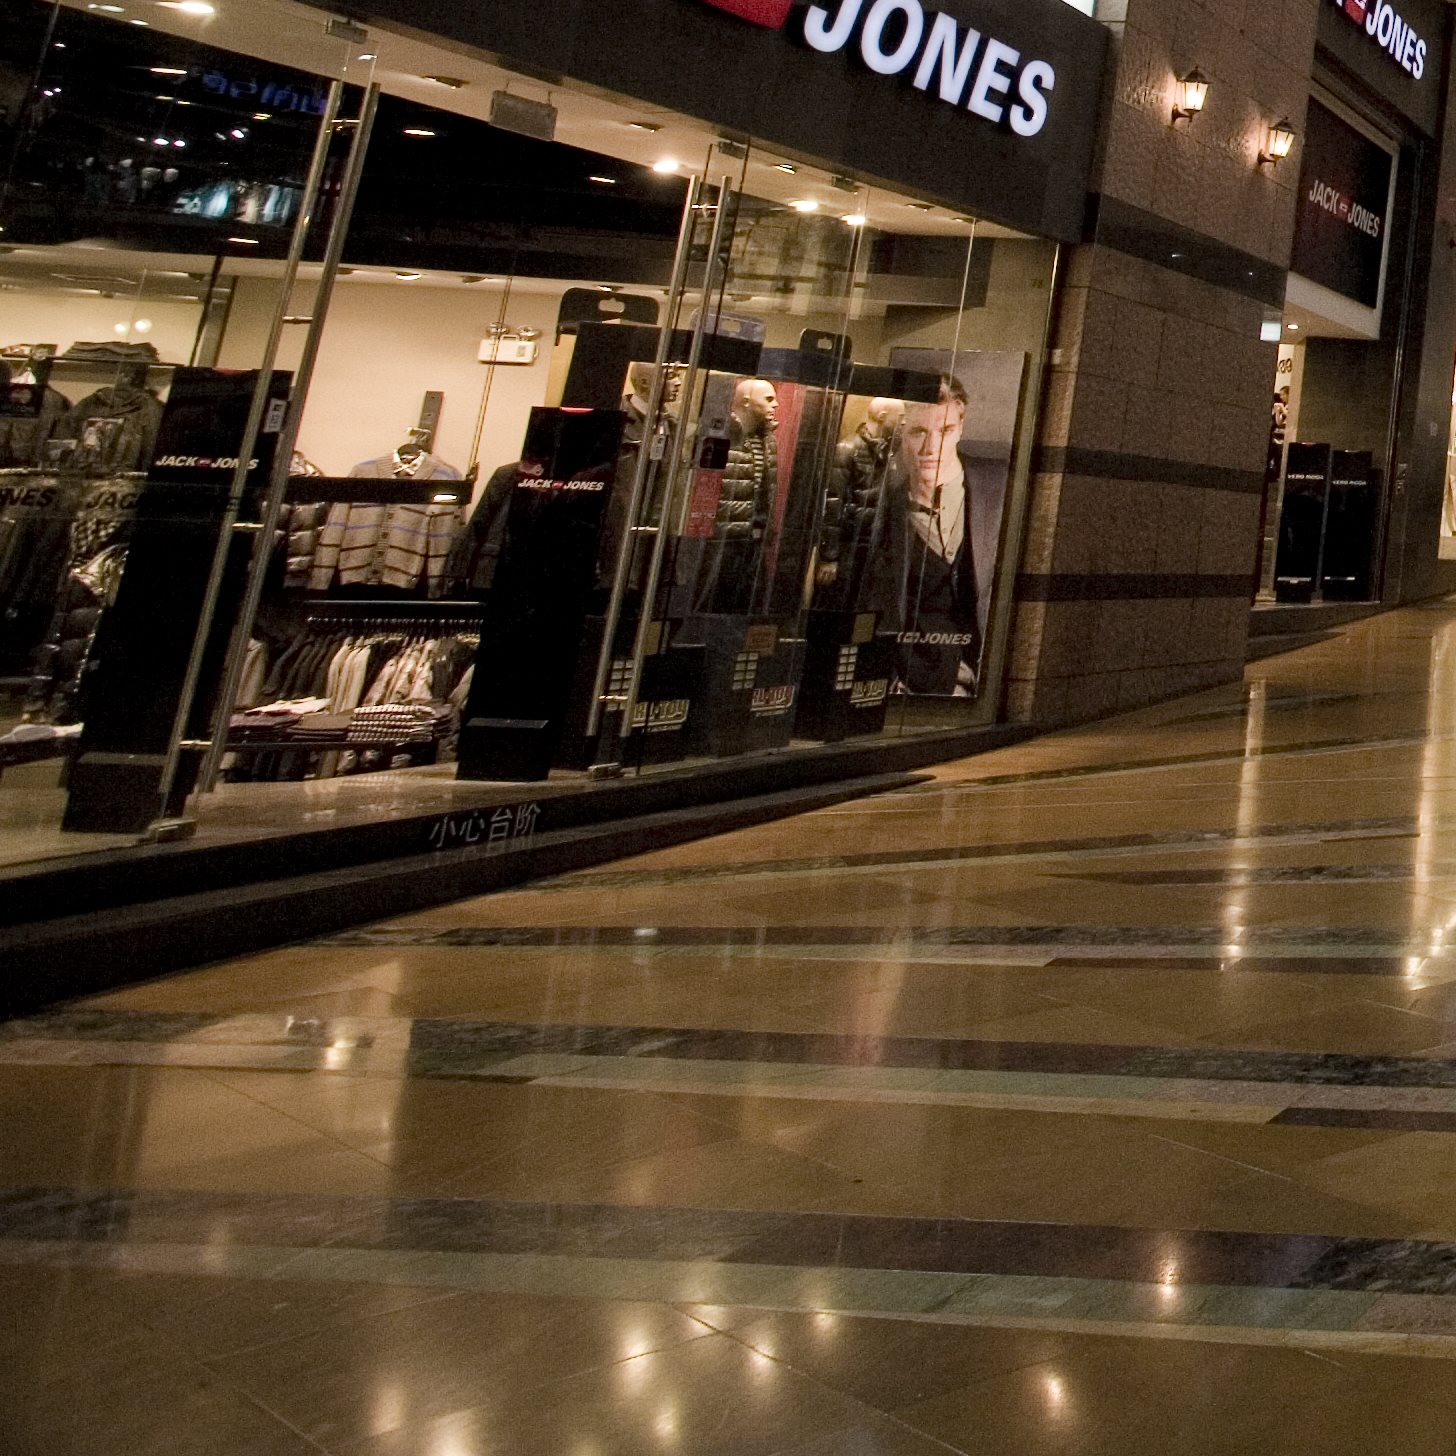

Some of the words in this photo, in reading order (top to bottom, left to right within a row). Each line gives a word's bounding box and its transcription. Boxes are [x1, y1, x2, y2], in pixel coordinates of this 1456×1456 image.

[1309, 179, 1341, 216] JACK
[1347, 199, 1381, 239] JONES
[155, 455, 199, 467] JACK
[211, 456, 260, 470] JONS
[517, 478, 553, 490] JACK
[563, 480, 605, 492] JONES
[917, 631, 973, 646] JONES
[428, 802, 542, 849] 小心台阶
